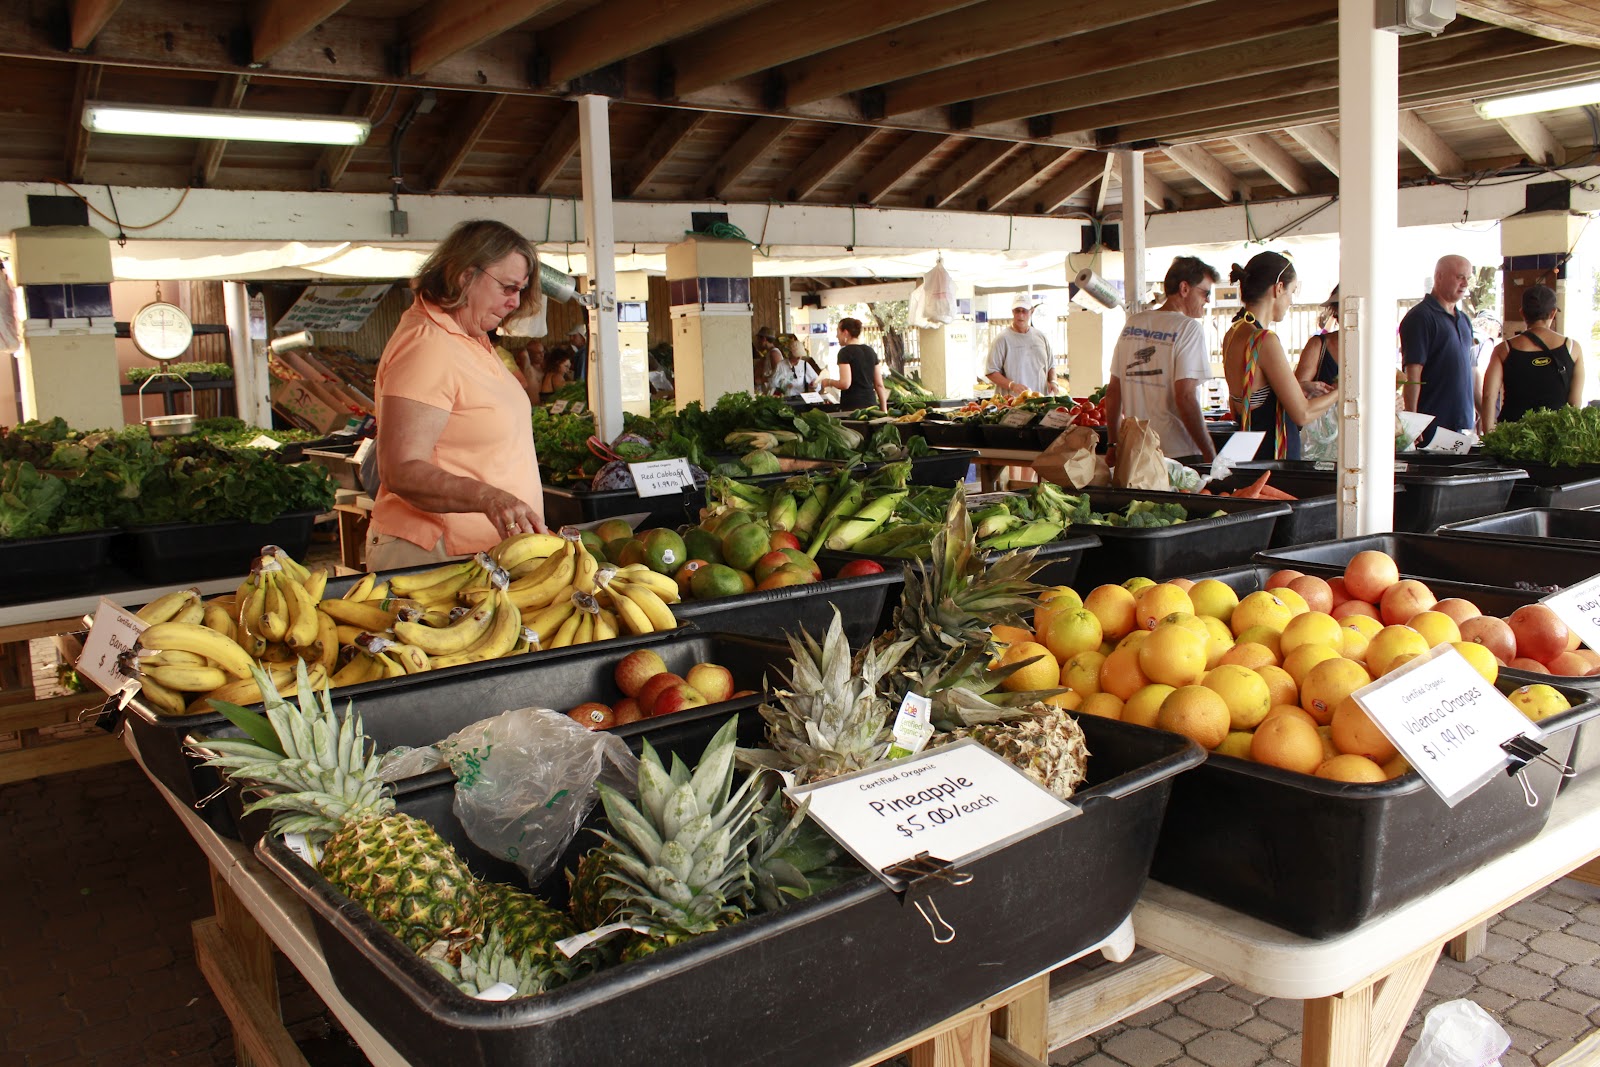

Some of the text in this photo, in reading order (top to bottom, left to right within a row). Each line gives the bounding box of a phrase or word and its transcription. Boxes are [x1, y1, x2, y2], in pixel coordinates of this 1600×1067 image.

[117, 615, 142, 635] Certified Orga
[109, 634, 129, 653] Bana
[1402, 677, 1446, 704] Certified Organic
[904, 702, 917, 715] Dole
[1401, 687, 1482, 735] Valencia Oranges
[901, 717, 924, 730] Certified
[859, 764, 937, 791] Certified Organic
[868, 776, 973, 817] Pineapple
[896, 794, 999, 838] $5.00/each
